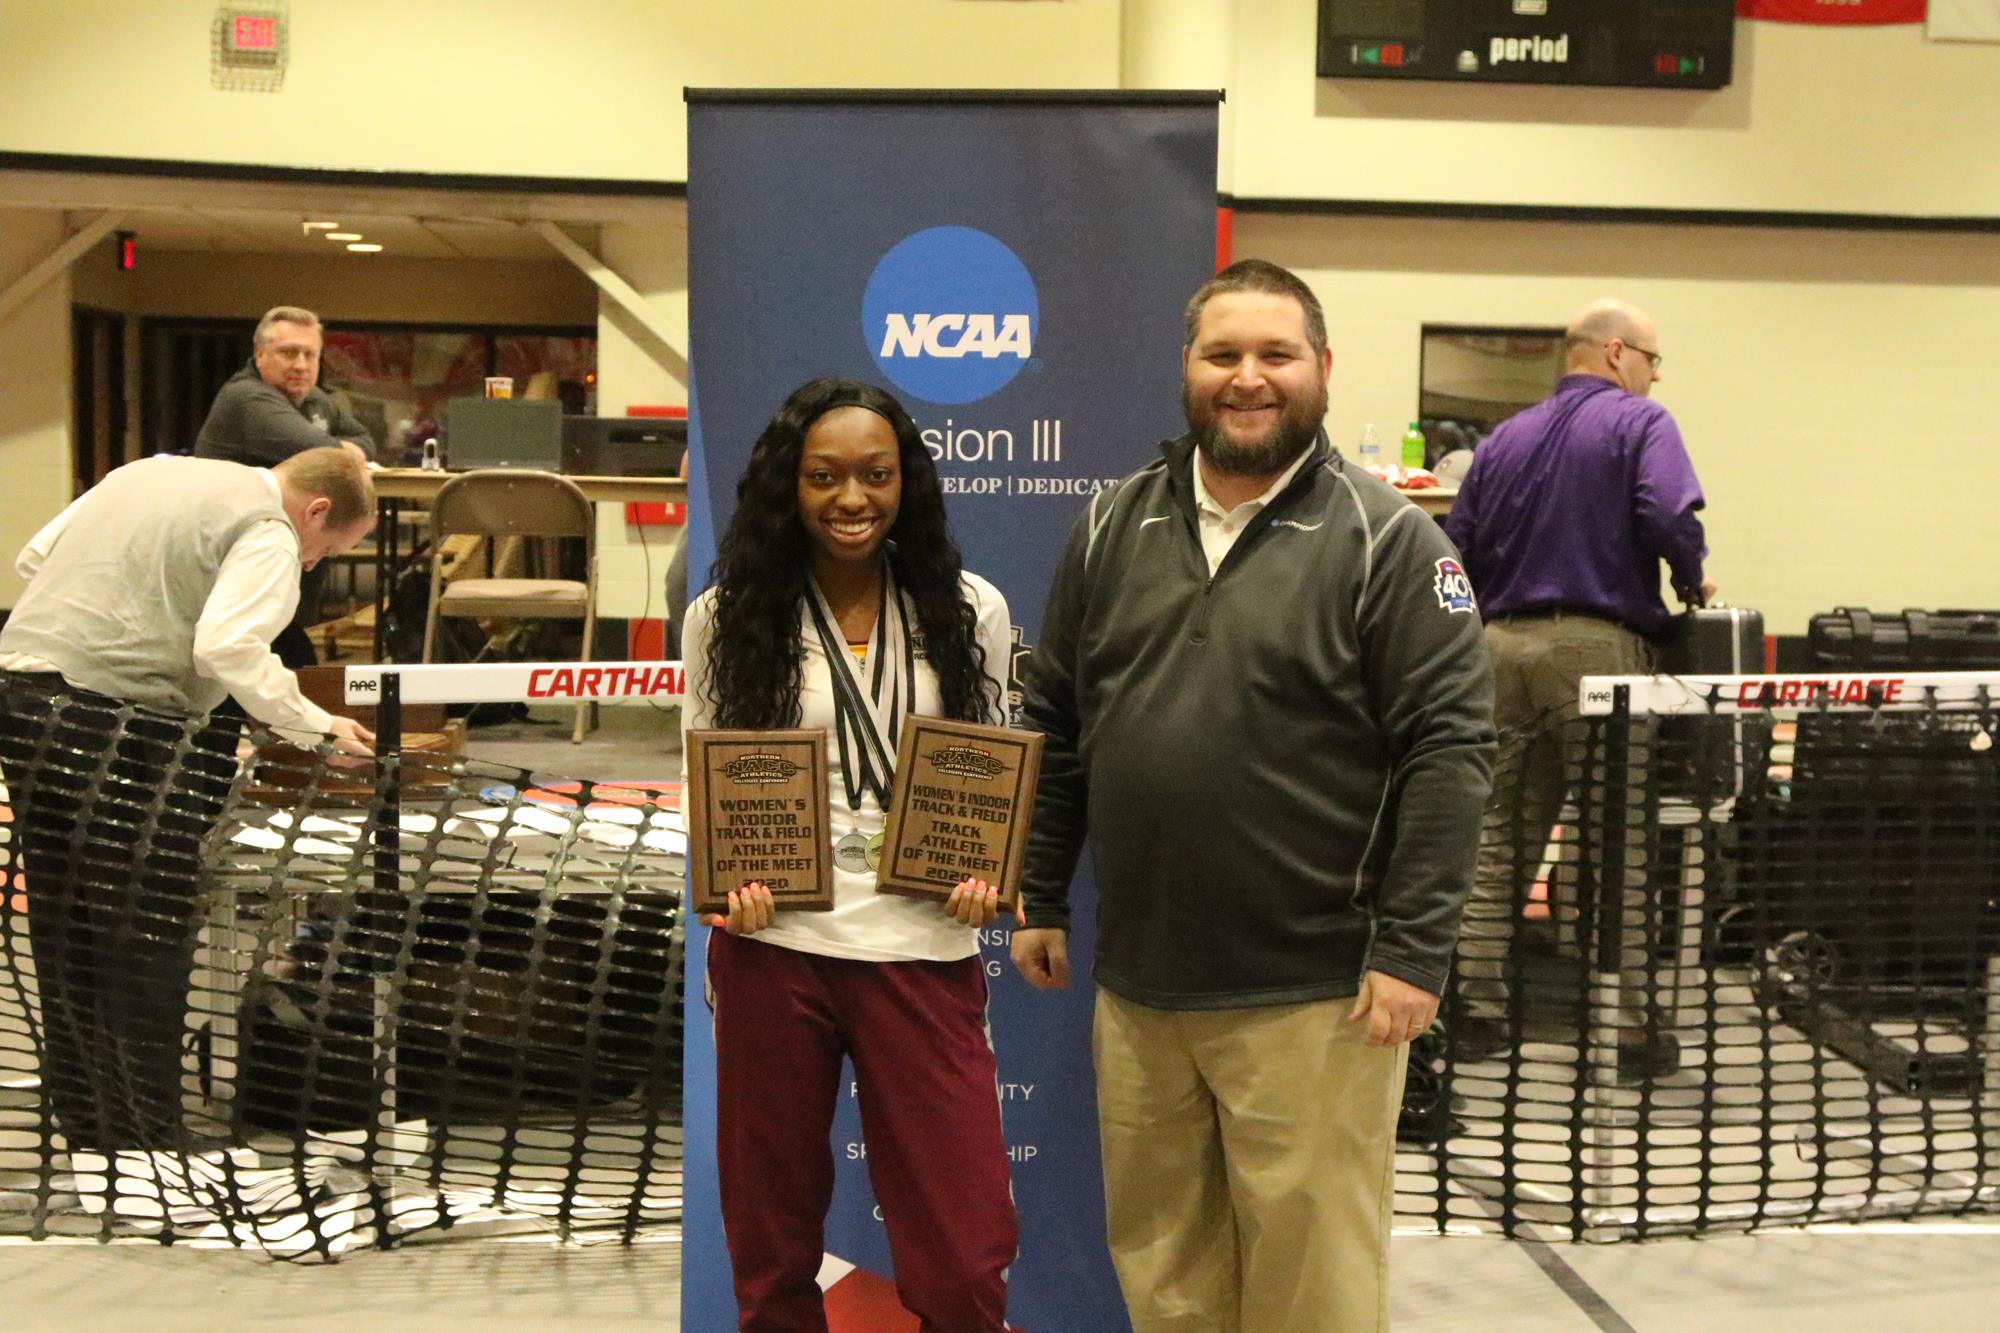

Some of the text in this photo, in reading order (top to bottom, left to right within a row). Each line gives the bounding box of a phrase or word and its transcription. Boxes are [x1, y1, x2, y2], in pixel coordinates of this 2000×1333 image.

[1490, 33, 1568, 66] period
[879, 313, 1032, 359] NCAA
[914, 419, 1061, 462] sion III
[938, 477, 1122, 495] ELOP DEDICAT
[1443, 574, 1468, 598] 40
[527, 667, 685, 698] CARTHA
[726, 760, 797, 776] NACC
[932, 751, 1002, 773] NACC
[945, 763, 988, 775] ATHLETICS
[719, 798, 807, 811] WOMEN'S
[912, 784, 1011, 810] WOMEN'S INDOOR
[729, 814, 797, 826] INDOOR
[911, 799, 1008, 824] TRACK & FIELD
[716, 827, 812, 840] TRACK & FIELD
[931, 820, 982, 839] TRACK
[731, 843, 797, 856] ATHLETE
[919, 835, 988, 855] ATHLETE
[716, 858, 813, 872] OF THE MEET
[903, 847, 1001, 873] OF THE MEET
[925, 867, 972, 883] 2020
